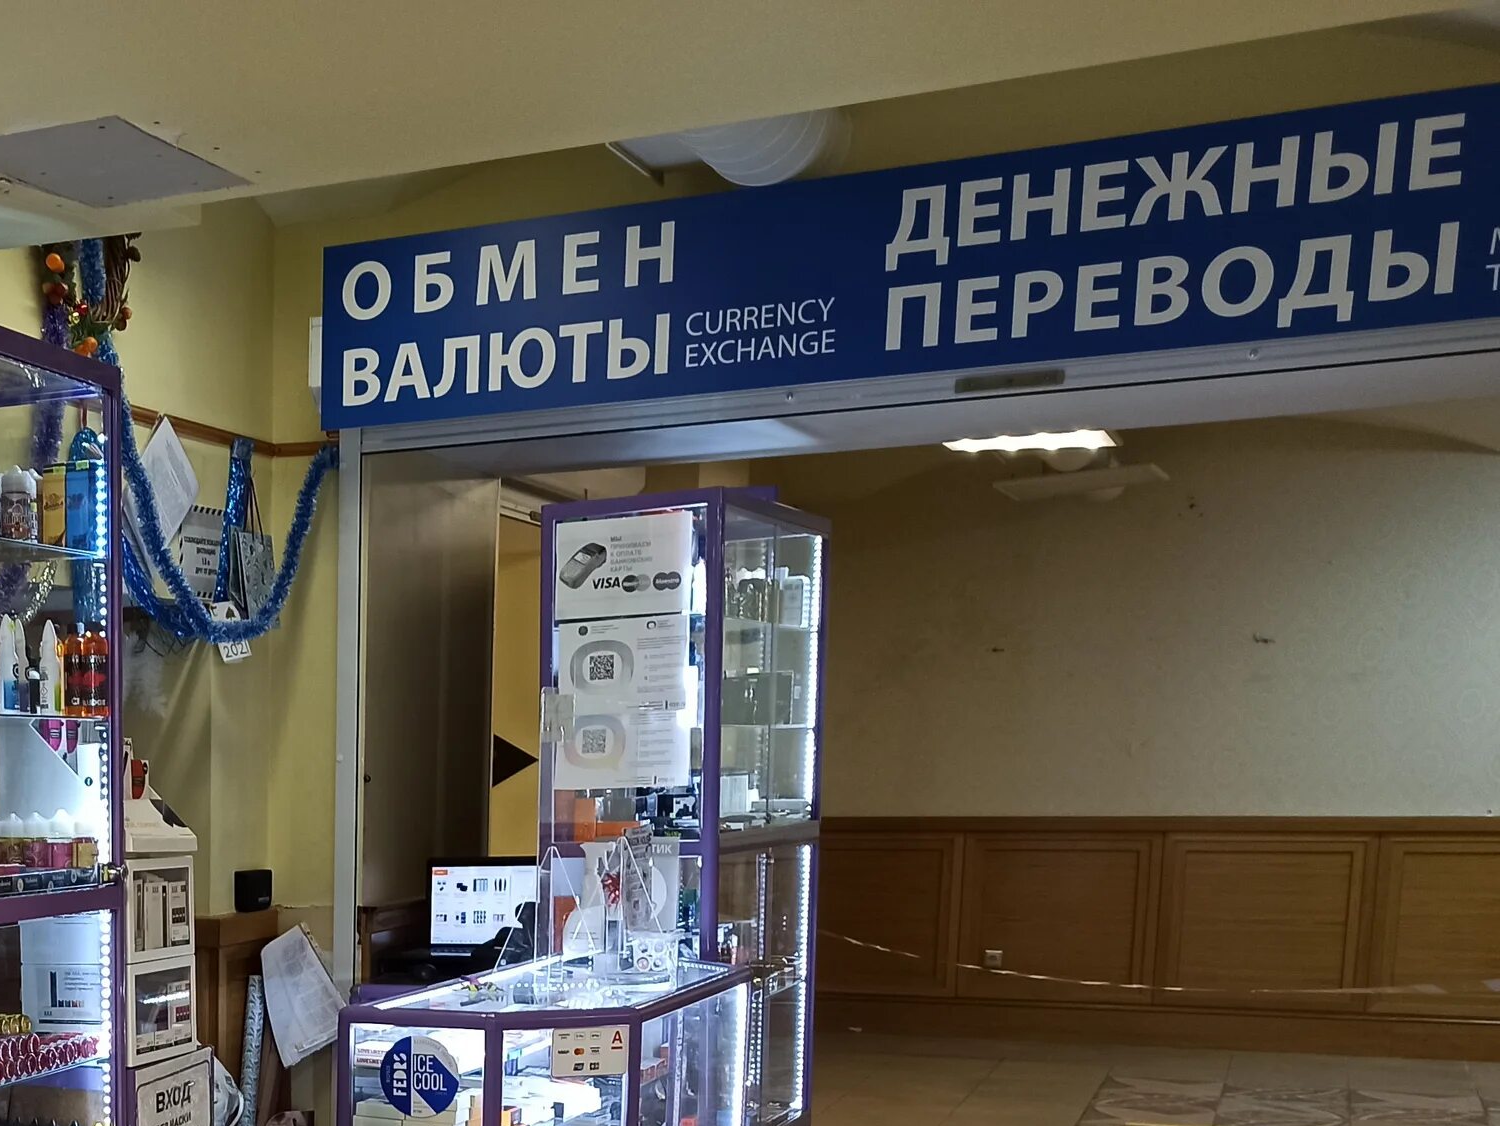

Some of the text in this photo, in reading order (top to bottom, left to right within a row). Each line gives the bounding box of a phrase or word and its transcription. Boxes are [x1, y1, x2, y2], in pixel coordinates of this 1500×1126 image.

[886, 113, 1467, 272] ДЕНЕЖНЫЕ
[342, 221, 676, 321] ОБМЕН
[885, 221, 1460, 352] ПЕРЕВОДЫ
[685, 297, 835, 337] CURRENCY
[342, 312, 670, 408] ВАЛЮТЫ
[685, 328, 836, 368] EXCHANGE
[592, 577, 621, 590] VISA
[223, 641, 250, 659] 2021
[413, 1055, 434, 1072] ICE
[413, 1073, 447, 1091] COOL
[155, 1080, 195, 1113] ВХОД
